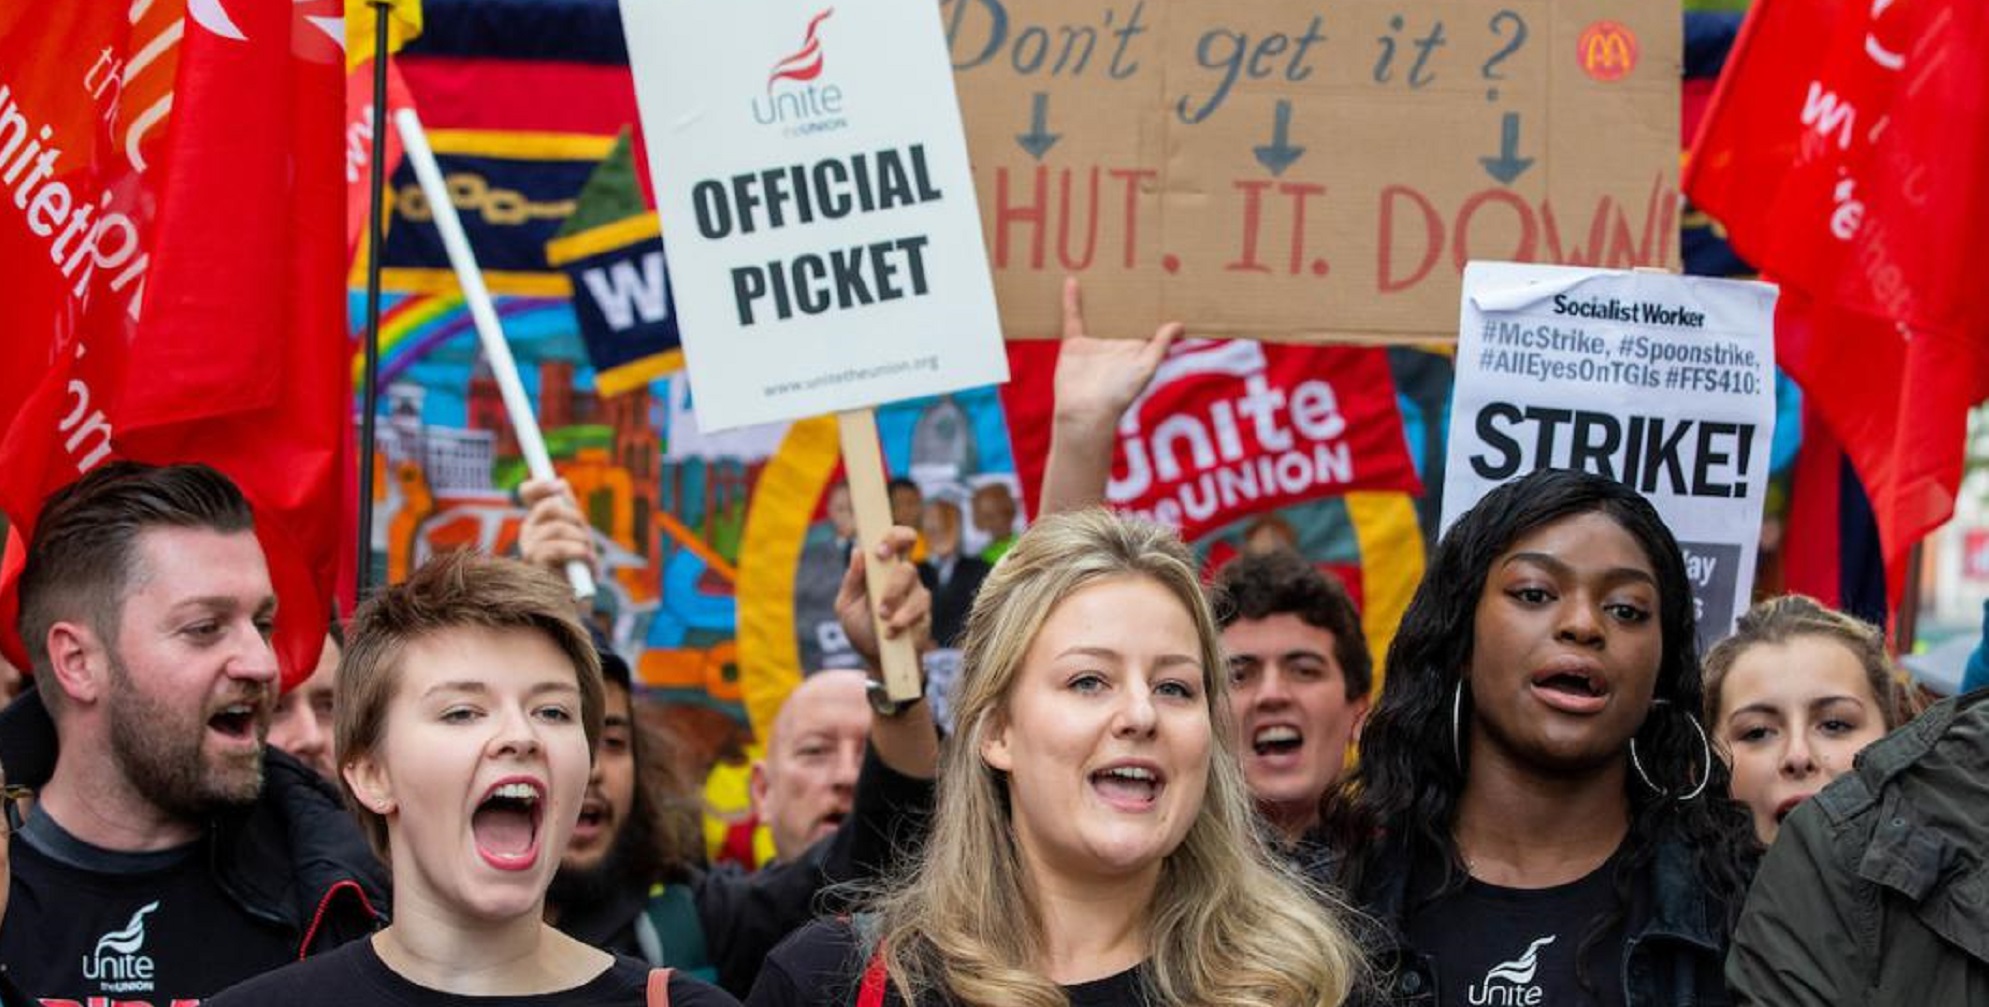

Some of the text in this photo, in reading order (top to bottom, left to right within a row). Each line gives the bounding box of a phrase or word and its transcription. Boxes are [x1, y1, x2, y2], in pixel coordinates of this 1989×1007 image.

[938, 0, 1147, 79] Don't
[1175, 15, 1327, 125] get
[692, 143, 943, 241] OFFICIAL
[972, 163, 1182, 275] HUT.
[1223, 180, 1330, 277] IT.
[731, 235, 930, 327] PICKET
[1552, 293, 1705, 328] Socialist Worker
[1479, 348, 1761, 396] #AllEyesOnTGIs #FFS410:
[1482, 319, 1761, 369] #McStrike, #Spoonstrike,
[1469, 401, 1756, 499] STRIKE!
